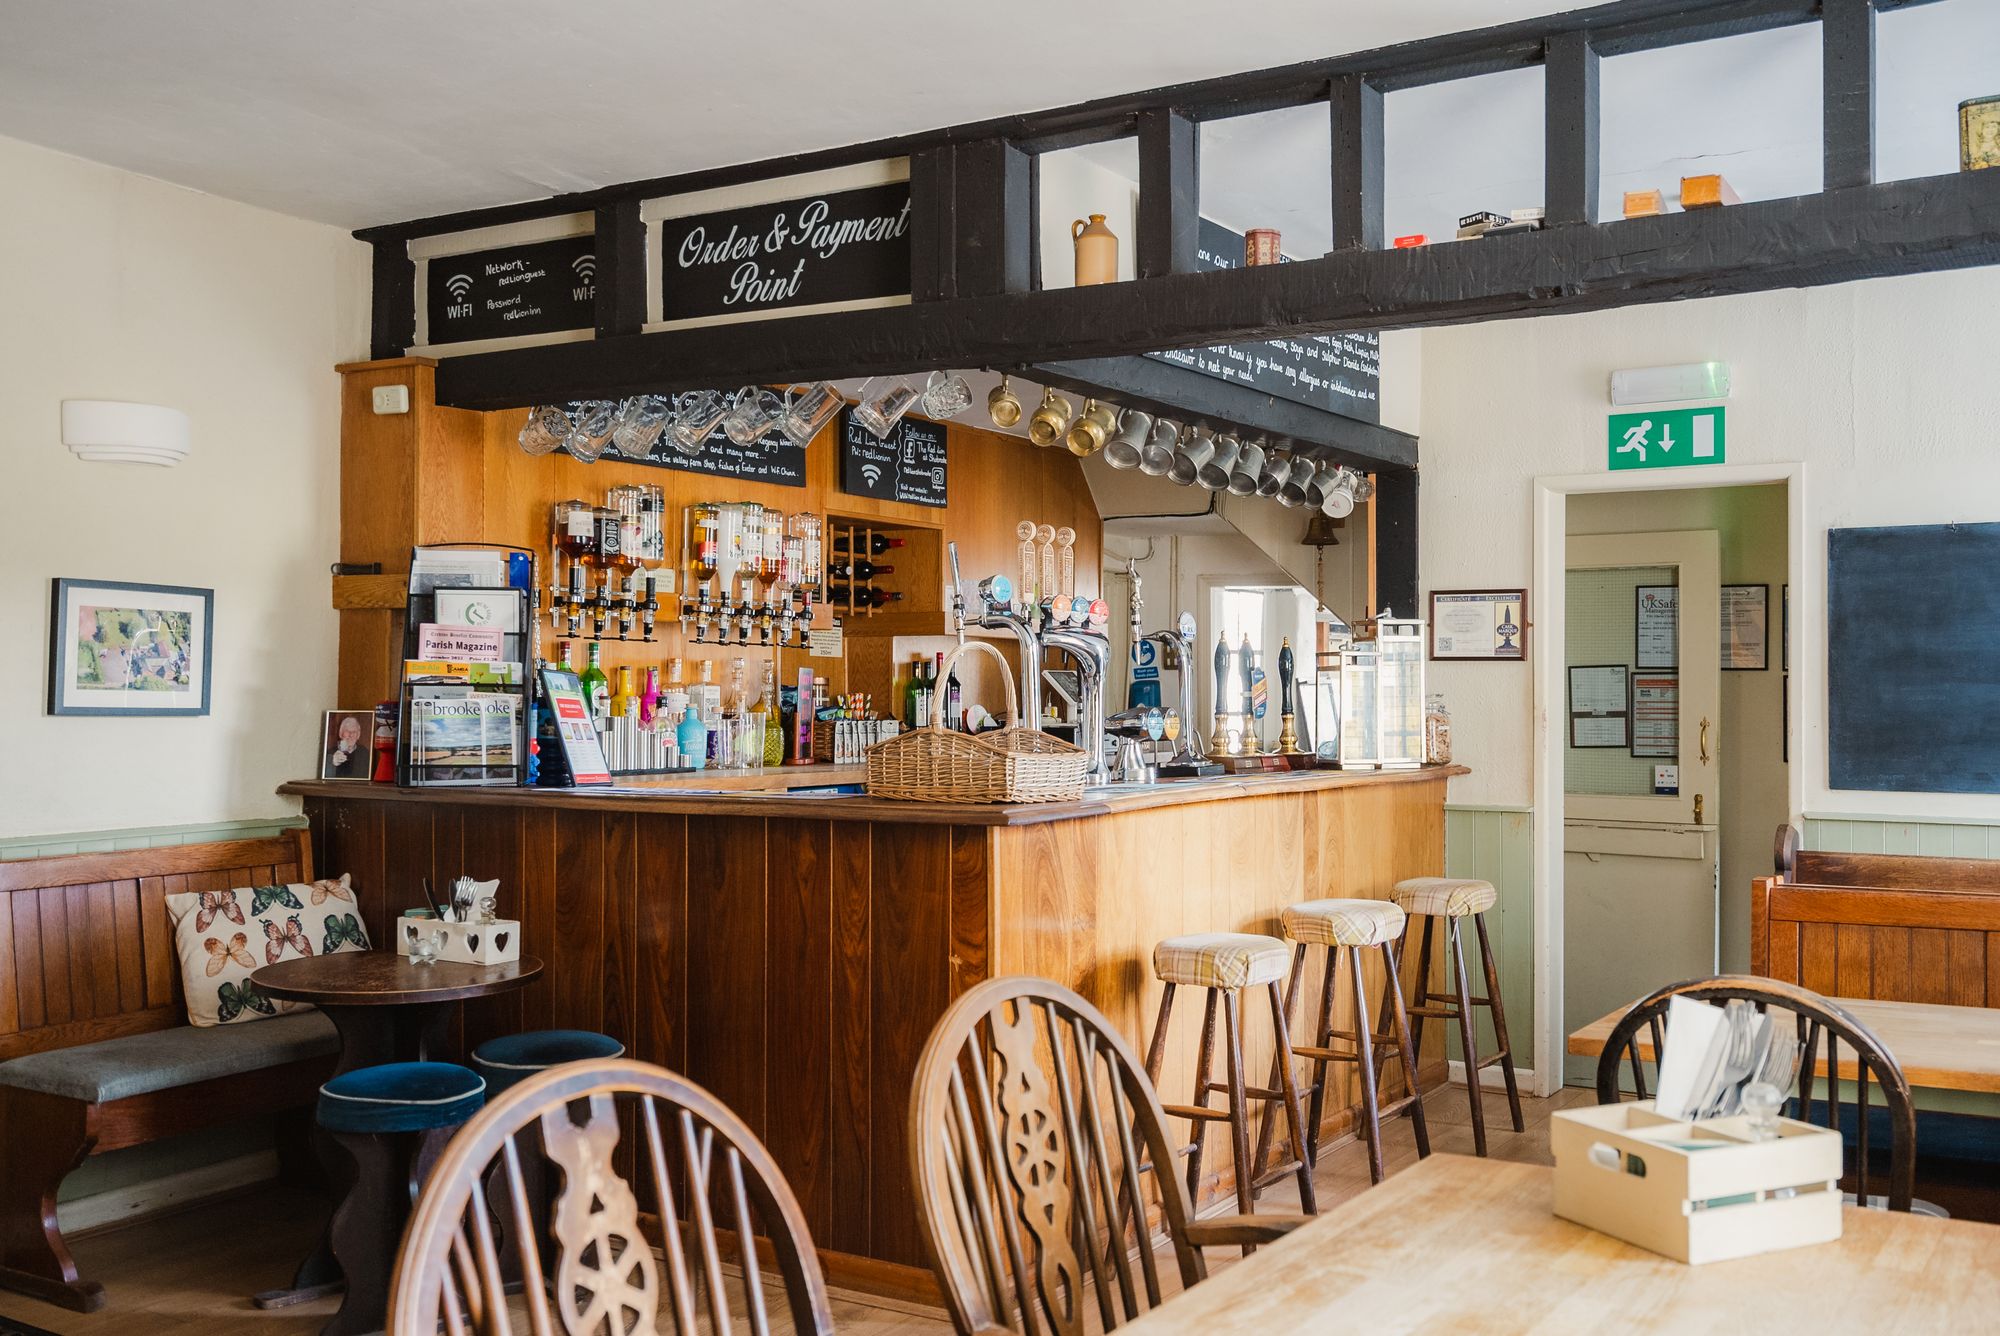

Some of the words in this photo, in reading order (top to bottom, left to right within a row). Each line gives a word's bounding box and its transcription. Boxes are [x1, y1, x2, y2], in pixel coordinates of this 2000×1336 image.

[678, 225, 760, 268] Order
[764, 213, 790, 253] &
[791, 197, 911, 259] Payment
[723, 258, 806, 305] Point
[709, 445, 725, 456] and
[425, 639, 454, 650] Parish
[455, 641, 499, 653] Magazine
